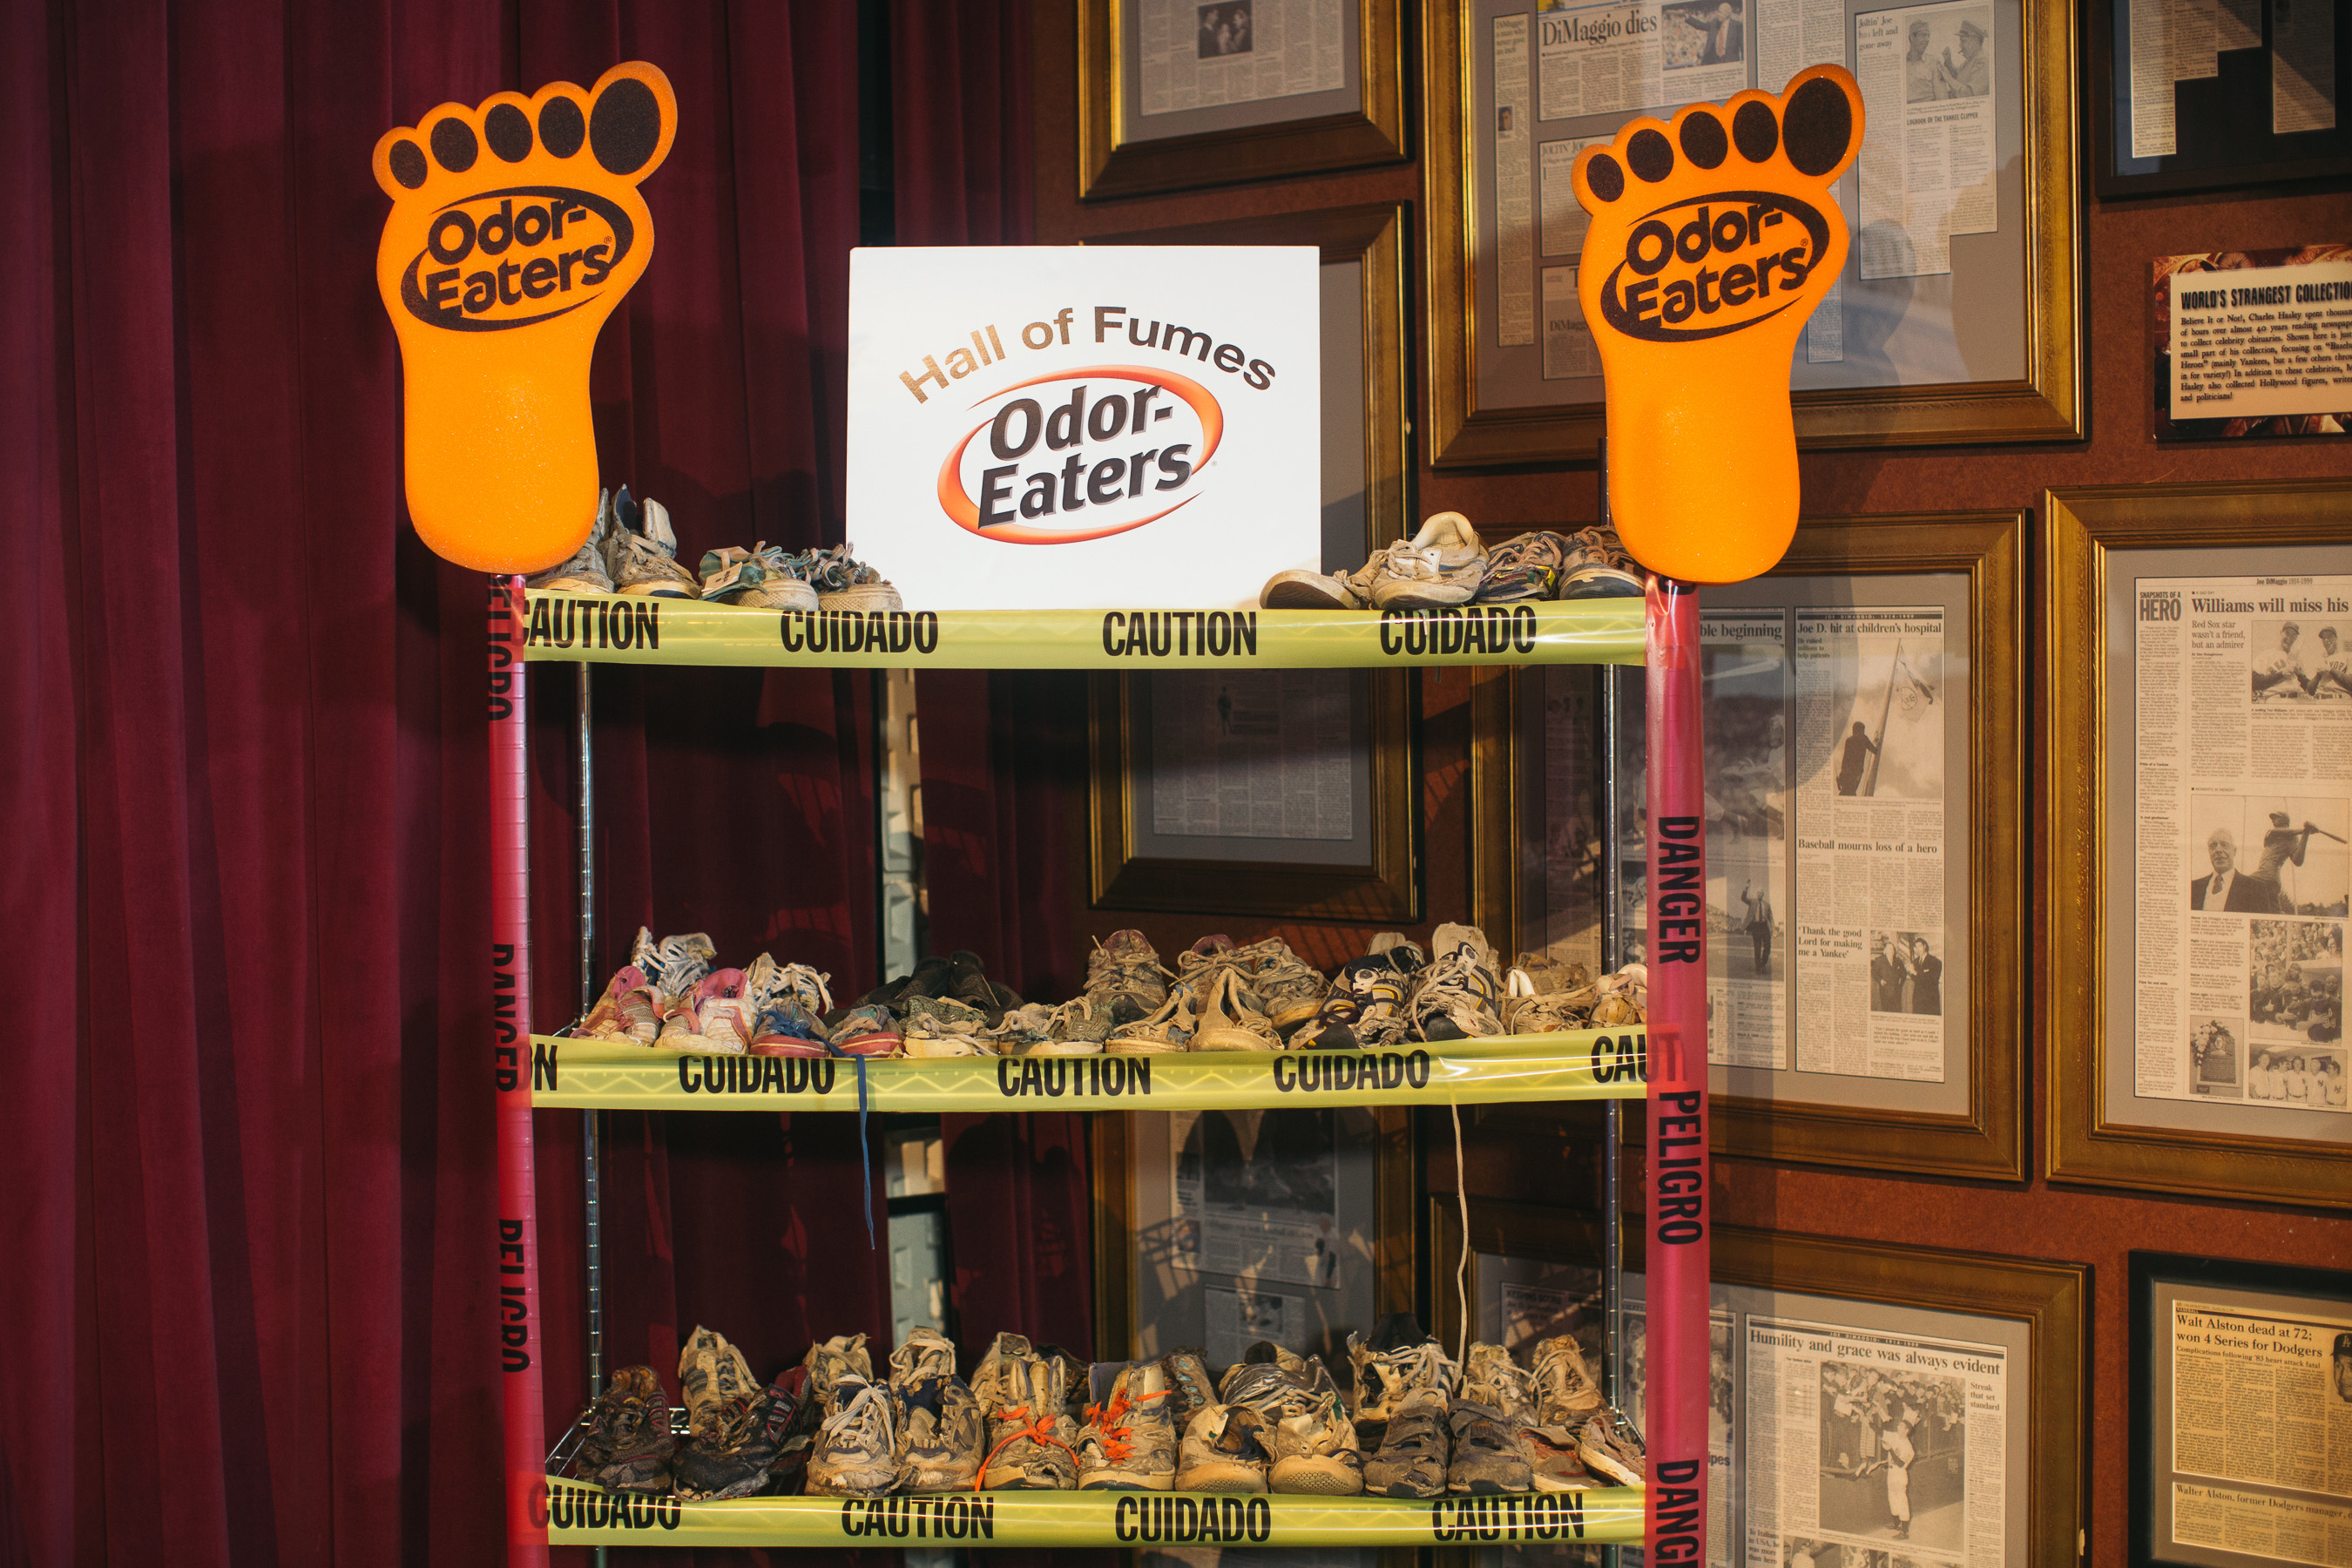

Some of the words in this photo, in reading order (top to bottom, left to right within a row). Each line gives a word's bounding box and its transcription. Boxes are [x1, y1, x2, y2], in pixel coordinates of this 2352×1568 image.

[1543, 13, 1621, 45] DiMaggio
[1625, 10, 1657, 35] dies
[1882, 16, 1893, 26] Joe
[428, 199, 587, 266] Odor-
[1625, 205, 1783, 276] Odor-
[426, 244, 611, 318] Eaters
[1625, 247, 1808, 328] Eaters
[2181, 289, 2227, 310] WORLD'S
[2231, 285, 2291, 307] STRANGEST
[2295, 280, 2352, 303] COLLECTIO
[2180, 317, 2204, 326] Believe
[2248, 313, 2274, 321] Charles
[2278, 311, 2302, 320] Hasley
[2305, 310, 2322, 320] spent
[2270, 324, 2288, 333] years
[2292, 321, 2317, 330] reading
[2190, 338, 2212, 347] collect
[2215, 337, 2245, 346] celebrity
[2247, 335, 2283, 343] obituaries.
[2286, 333, 2309, 341] Shown
[898, 323, 1006, 404] Hall
[1021, 307, 1074, 351] of
[1093, 305, 1276, 392] Fumes
[2180, 349, 2198, 358] small
[2202, 350, 2215, 359] part
[2281, 344, 2309, 354] focusing
[2211, 359, 2236, 368] (mainly
[2295, 355, 2308, 363] few
[2203, 369, 2231, 380] variety!)
[2245, 368, 2272, 376] addition
[2305, 364, 2342, 374] celebrities,
[2180, 382, 2204, 391] Hasley
[2226, 380, 2255, 389] collected
[2260, 377, 2297, 388] Hollywood
[2301, 376, 2328, 387] figures,
[2180, 393, 2193, 402] and
[2196, 392, 2233, 403] politicians!
[990, 385, 1173, 462] Odor-
[977, 443, 1193, 531] Eaters
[2139, 598, 2182, 621] HERO
[2192, 598, 2255, 613] Williams
[2258, 598, 2285, 612] will
[2289, 597, 2322, 612] miss
[2327, 597, 2349, 612] his
[781, 609, 939, 654] CUIDADO
[1102, 611, 1258, 657] CAUTION
[1380, 605, 1537, 655] CUIDADO
[1720, 623, 1782, 641] beginning
[1797, 622, 1814, 633] Joe
[1816, 622, 1828, 633] D.
[1830, 622, 1842, 633] hit
[1845, 624, 1855, 633] at
[1857, 622, 1902, 633] children's
[1904, 621, 1942, 636] hospital
[2221, 630, 2246, 640] friend,
[2192, 640, 2204, 649] but
[2216, 640, 2245, 649] admirer
[1798, 839, 1835, 849] Baseball
[1838, 841, 1873, 851] mourns
[1876, 841, 1892, 852] loss
[1896, 842, 1905, 852] of
[1916, 842, 1937, 854] hero
[1657, 816, 1700, 964] DANGER
[1798, 936, 1817, 945] Lord
[1820, 937, 1831, 946] for
[1834, 940, 1862, 950] making
[1828, 927, 1841, 936] the
[1843, 929, 1862, 938] good
[678, 1056, 835, 1096] CUIDADO
[997, 1056, 1152, 1098] CAUTION
[1273, 1048, 1429, 1093] CUIDADO
[1658, 1090, 1704, 1247] PELIGRO
[2177, 1314, 2203, 1328] Walt
[2207, 1318, 2245, 1333] Alston
[2247, 1322, 2275, 1336] dead
[2279, 1328, 2290, 1337] at
[2294, 1328, 2312, 1342] 72;
[1750, 1329, 1804, 1352] Humility
[1808, 1340, 1832, 1353] and
[1837, 1344, 1872, 1358] grace
[1877, 1349, 1901, 1362] was
[1905, 1351, 1948, 1371] always
[1952, 1357, 2000, 1375] evident
[2177, 1333, 2200, 1342] won
[2204, 1333, 2212, 1344] 4
[2214, 1335, 2249, 1348] Series
[2252, 1339, 2269, 1351] for
[2272, 1341, 2323, 1358] Dodgers
[2176, 1346, 2221, 1357] Complications
[2222, 1350, 2253, 1362] following
[2283, 1358, 2304, 1367] attack
[1970, 1382, 1993, 1392] Streak
[1970, 1391, 1984, 1400] that
[1970, 1401, 2000, 1411] standard
[2176, 1484, 2203, 1497] Walter
[2237, 1494, 2267, 1506] former
[2268, 1498, 2304, 1512] Dodgers
[2306, 1506, 2346, 1519] manager,
[528, 1482, 682, 1531] CUIDADO
[841, 1496, 995, 1540] CAUTION
[1114, 1495, 1272, 1543] CUIDADO
[1431, 1491, 1585, 1543] CAUTION
[1655, 1459, 1700, 1568] DANG
